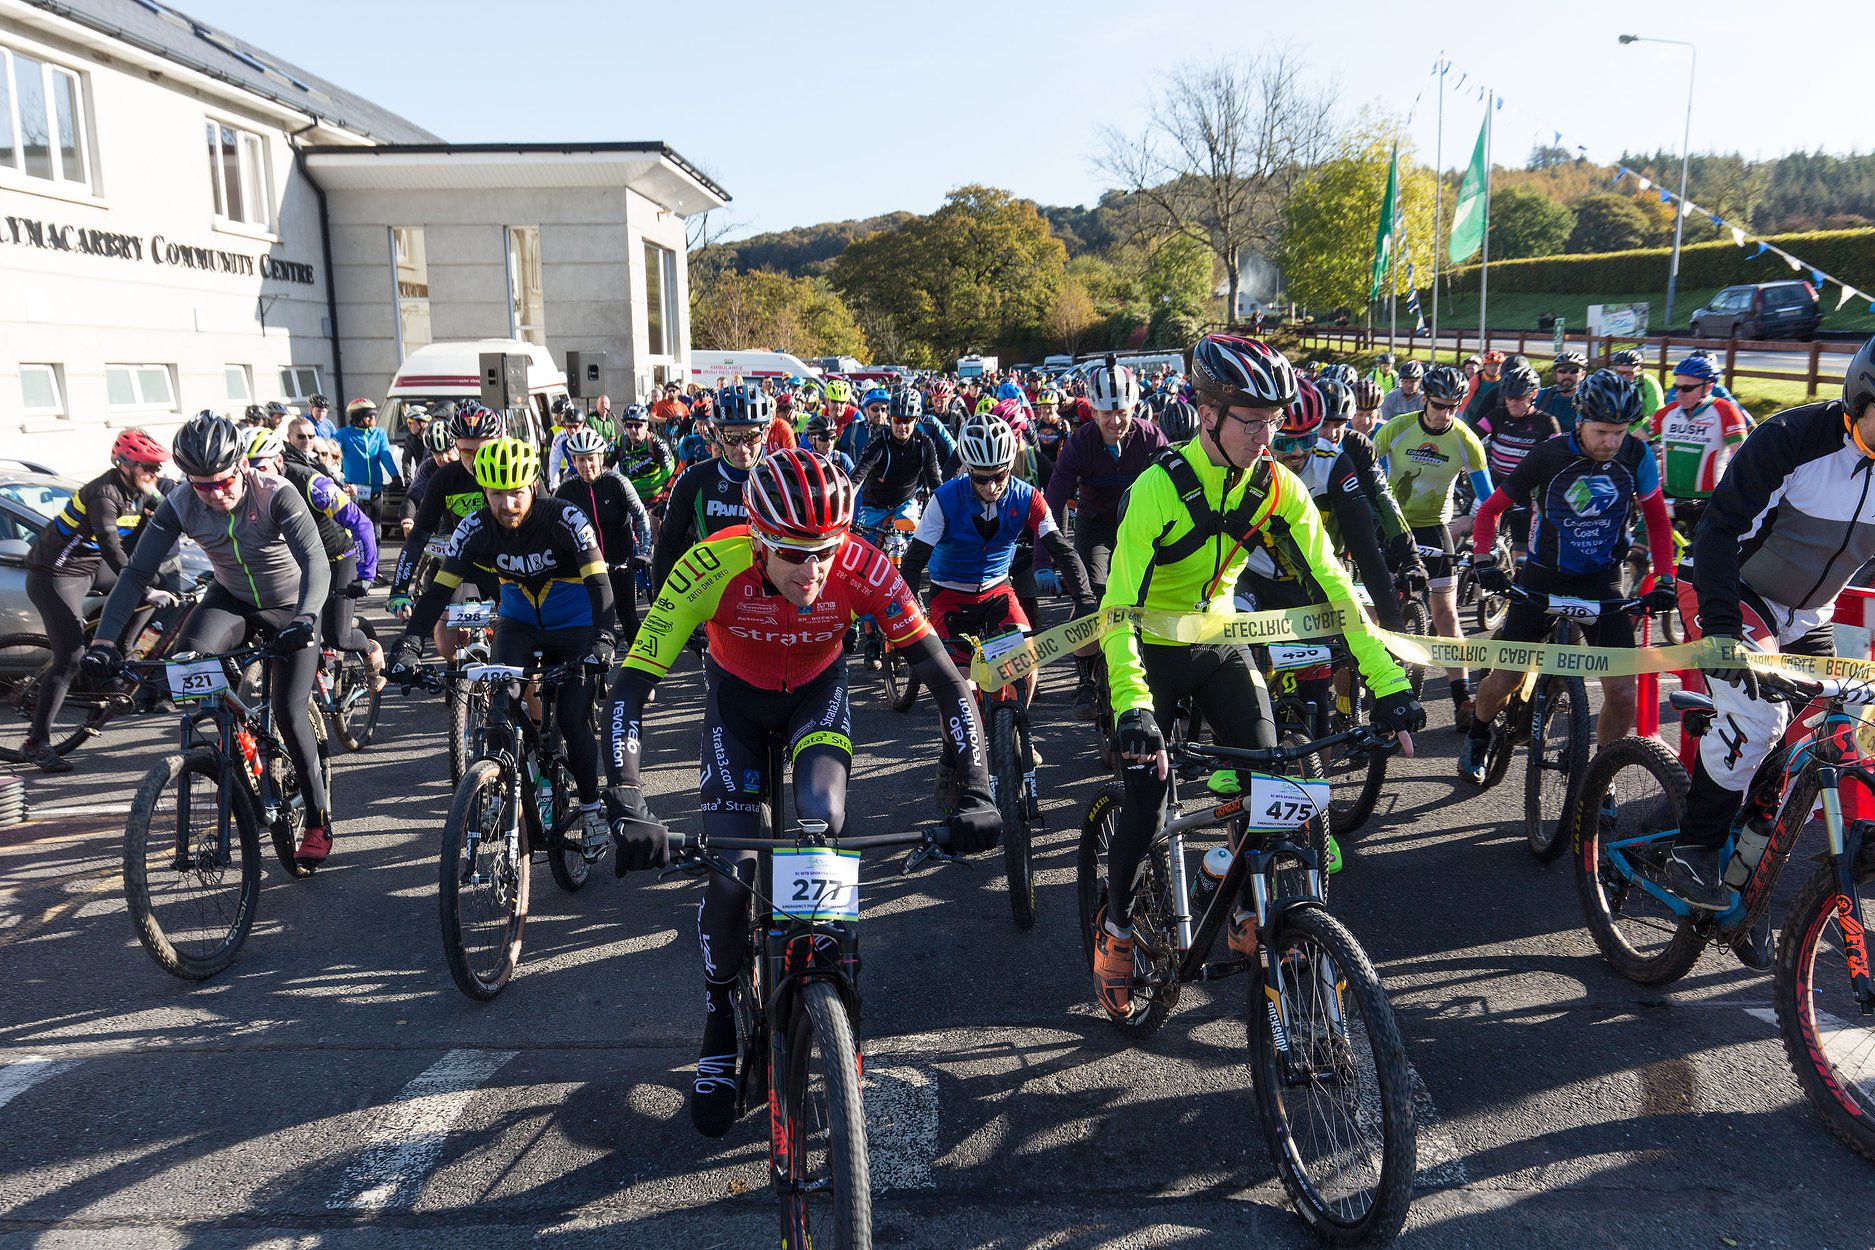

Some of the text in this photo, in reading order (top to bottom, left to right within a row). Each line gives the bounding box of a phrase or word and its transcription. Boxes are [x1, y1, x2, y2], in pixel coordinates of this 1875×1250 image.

[1669, 424, 1707, 436] BUSH
[1573, 528, 1600, 538] Coast
[667, 546, 721, 594] 010
[842, 541, 890, 587] 010
[456, 613, 481, 622] 298
[182, 674, 212, 689] 321
[820, 686, 843, 727] Strata3.com
[611, 700, 625, 768] revolution
[627, 720, 640, 754] velo
[950, 716, 966, 753] velo
[958, 698, 981, 767] revolution
[713, 726, 736, 792] Strata3.com
[1088, 795, 1110, 822] MAXXIS
[1266, 801, 1313, 820] 475
[1574, 799, 1584, 855] MAXXIS
[792, 879, 842, 901] 277
[1845, 934, 1870, 978] FOX
